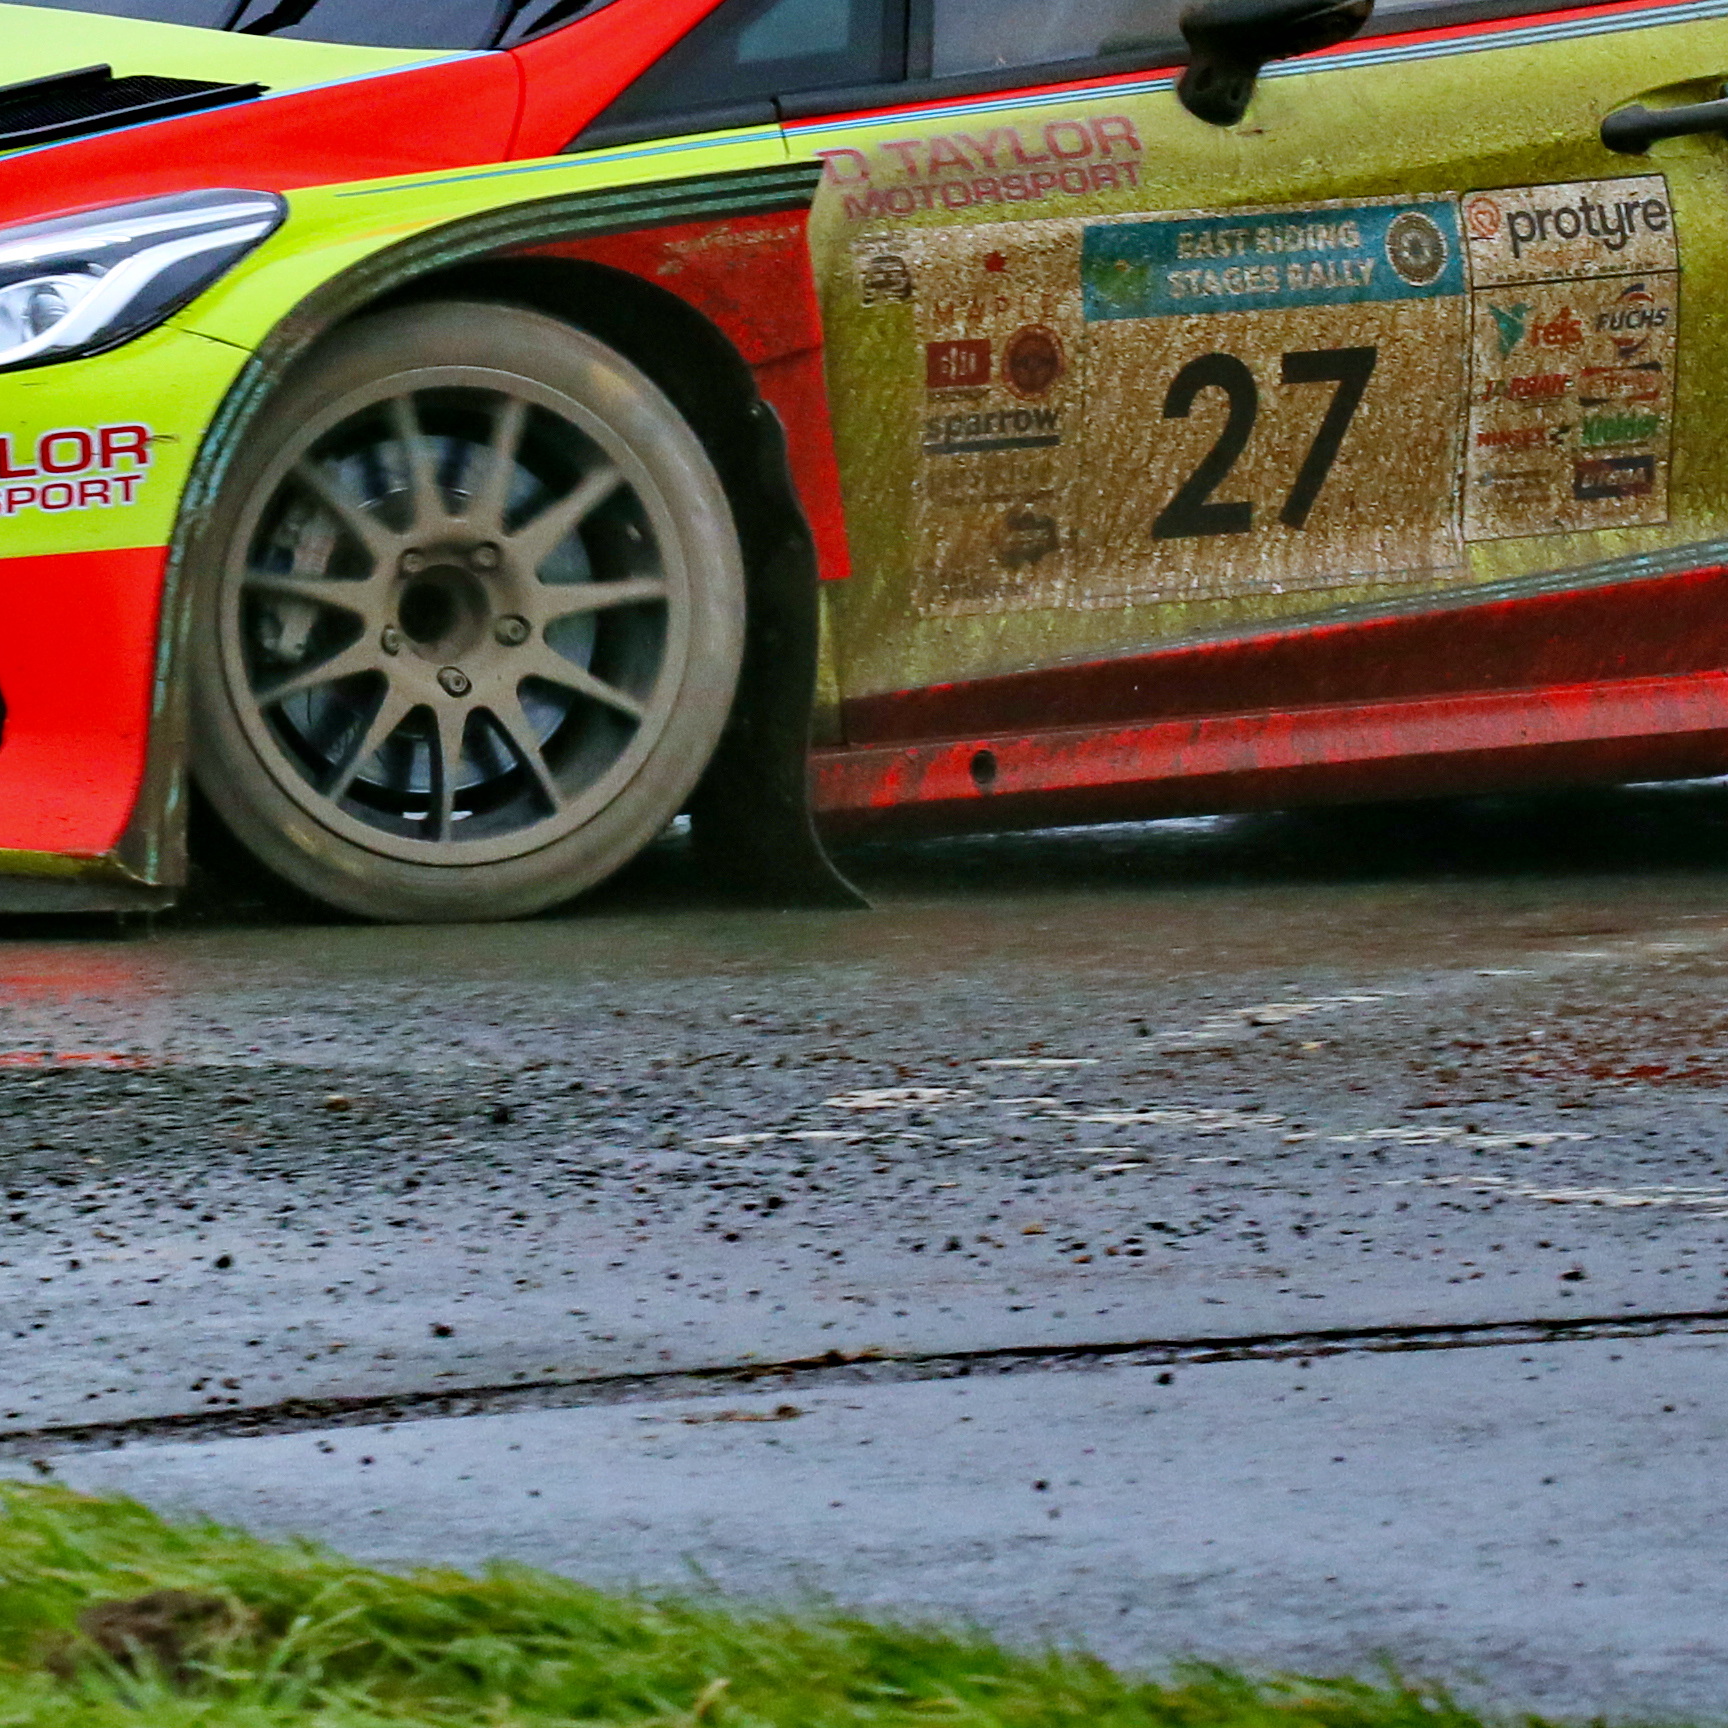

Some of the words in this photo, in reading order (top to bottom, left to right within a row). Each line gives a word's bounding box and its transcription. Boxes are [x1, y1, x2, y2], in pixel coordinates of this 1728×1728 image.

[815, 148, 871, 186] D
[883, 116, 1143, 177] TAYLOR
[843, 160, 1141, 220] MOTORSPORT
[1177, 227, 1247, 259] EAST
[1255, 221, 1361, 254] RIDING
[1506, 196, 1667, 259] protyre
[1167, 266, 1281, 298] STAGES
[1287, 257, 1375, 290] RALLY
[1596, 308, 1670, 332] FUCHS
[925, 408, 1060, 443] sparrow
[1151, 346, 1377, 541] 27
